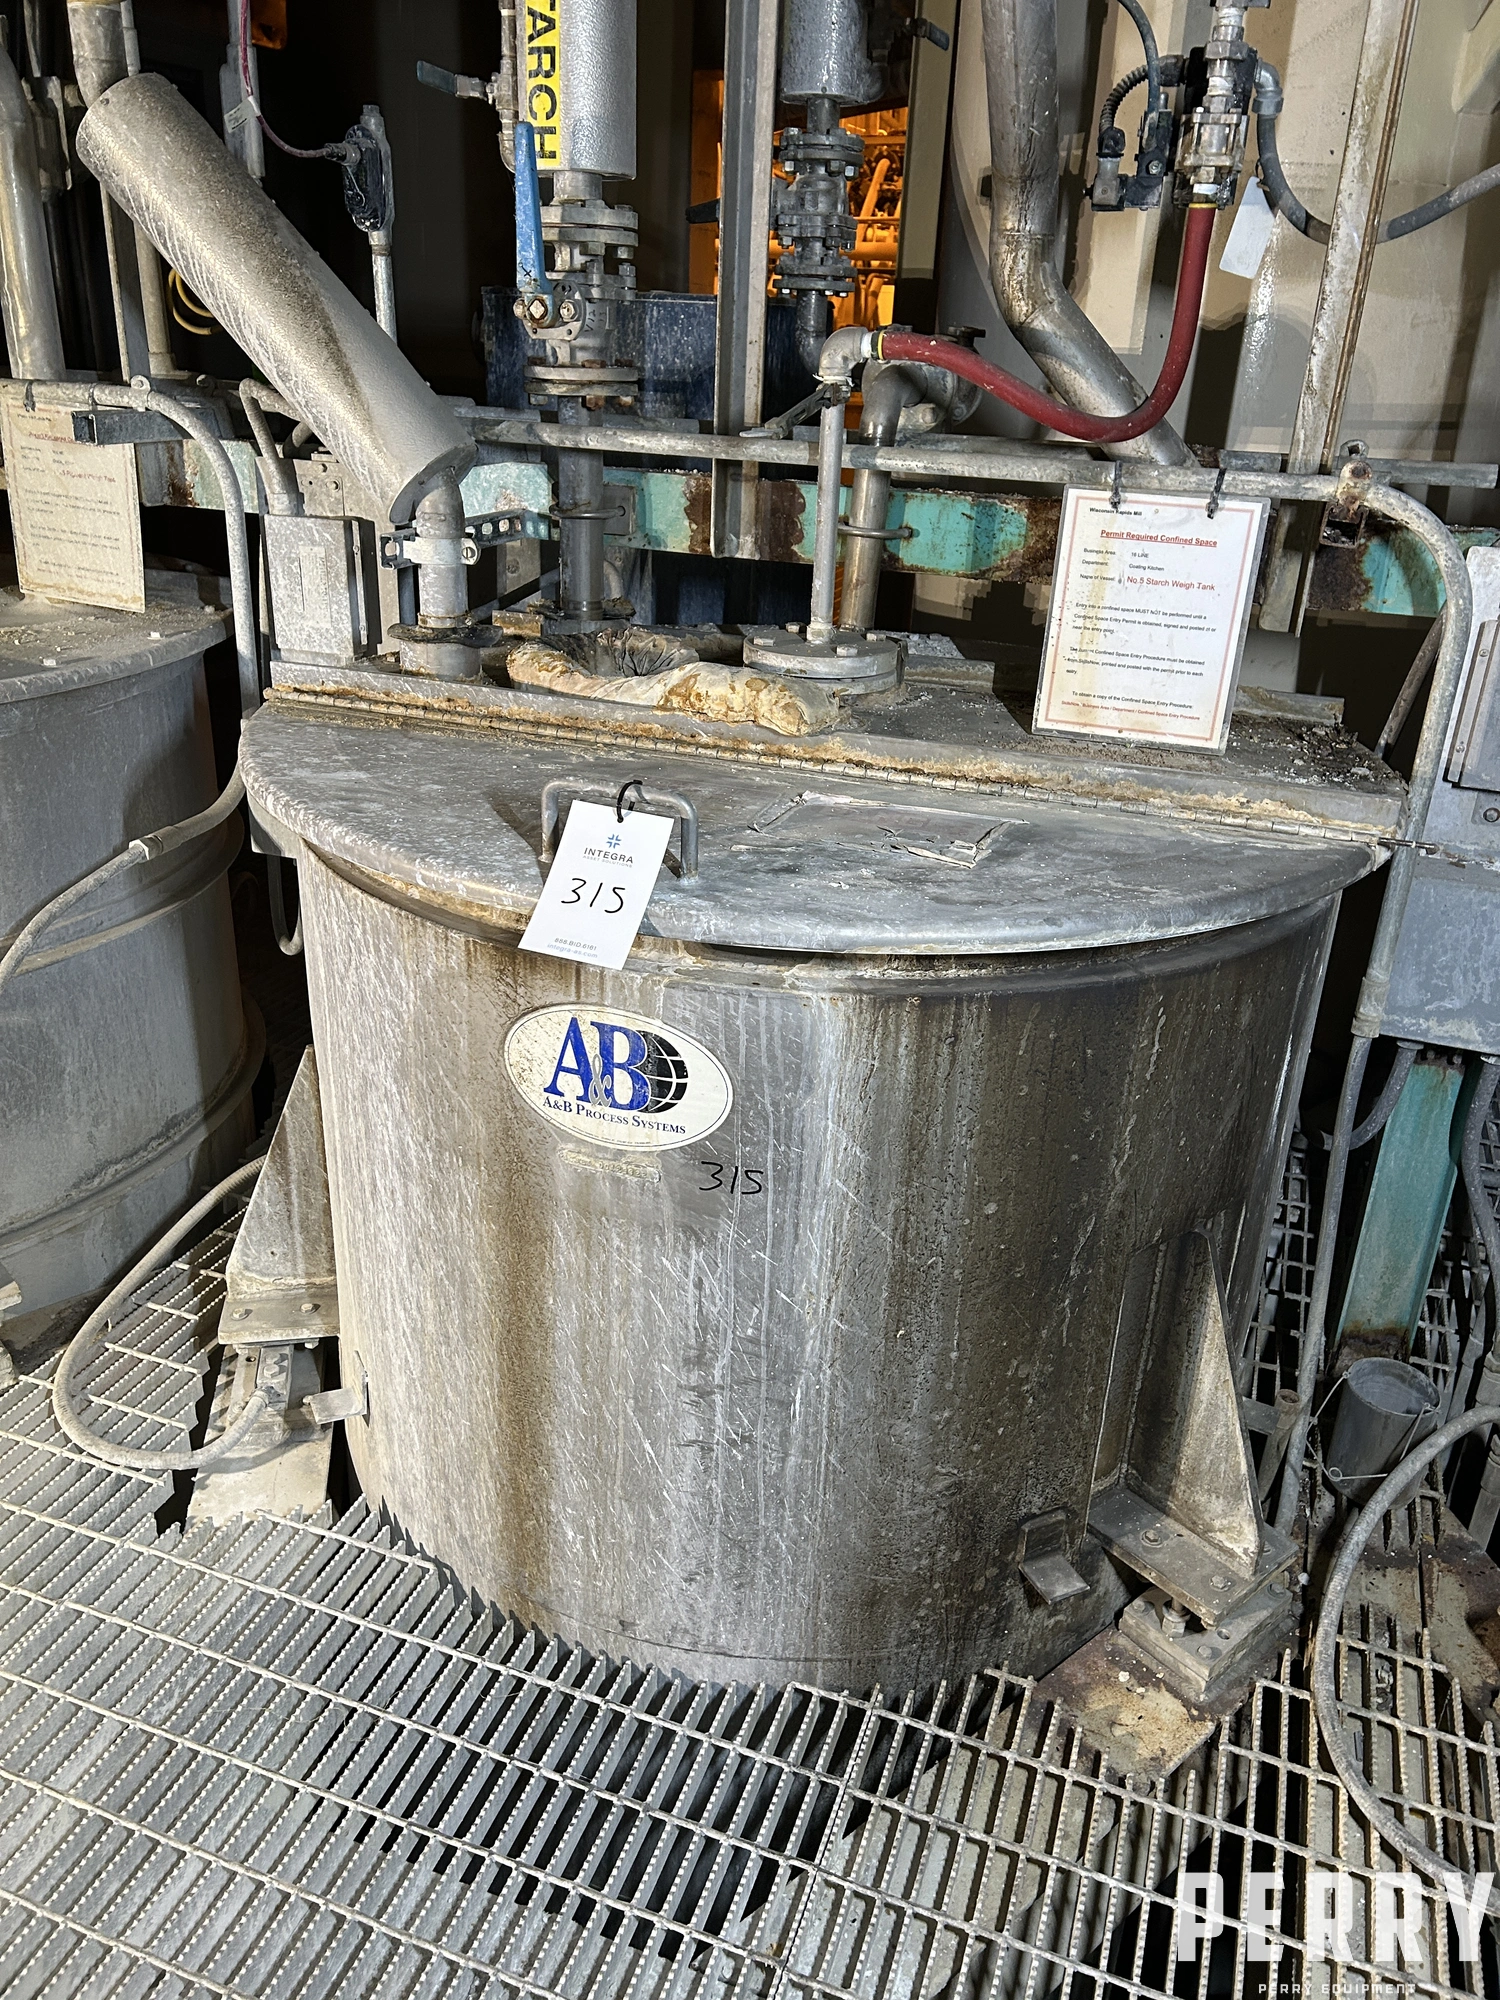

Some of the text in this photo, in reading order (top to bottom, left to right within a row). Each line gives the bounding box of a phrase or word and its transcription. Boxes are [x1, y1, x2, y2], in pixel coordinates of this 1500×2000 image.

[1100, 529, 1217, 547] Permit Required Confined Space
[1146, 577, 1169, 586] Starch
[1170, 580, 1194, 589] Weigh
[1196, 582, 1215, 590] Tank
[584, 847, 634, 864] INTEGRA
[602, 858, 632, 868] SOLUTIONS
[561, 878, 626, 914] 315
[547, 943, 598, 959] integra-as.com
[543, 1017, 652, 1111] A&B
[543, 1096, 573, 1114] A&B
[575, 1103, 629, 1127] PROCESS
[631, 1115, 686, 1135] SYSTEMS
[699, 1161, 764, 1195] 315
